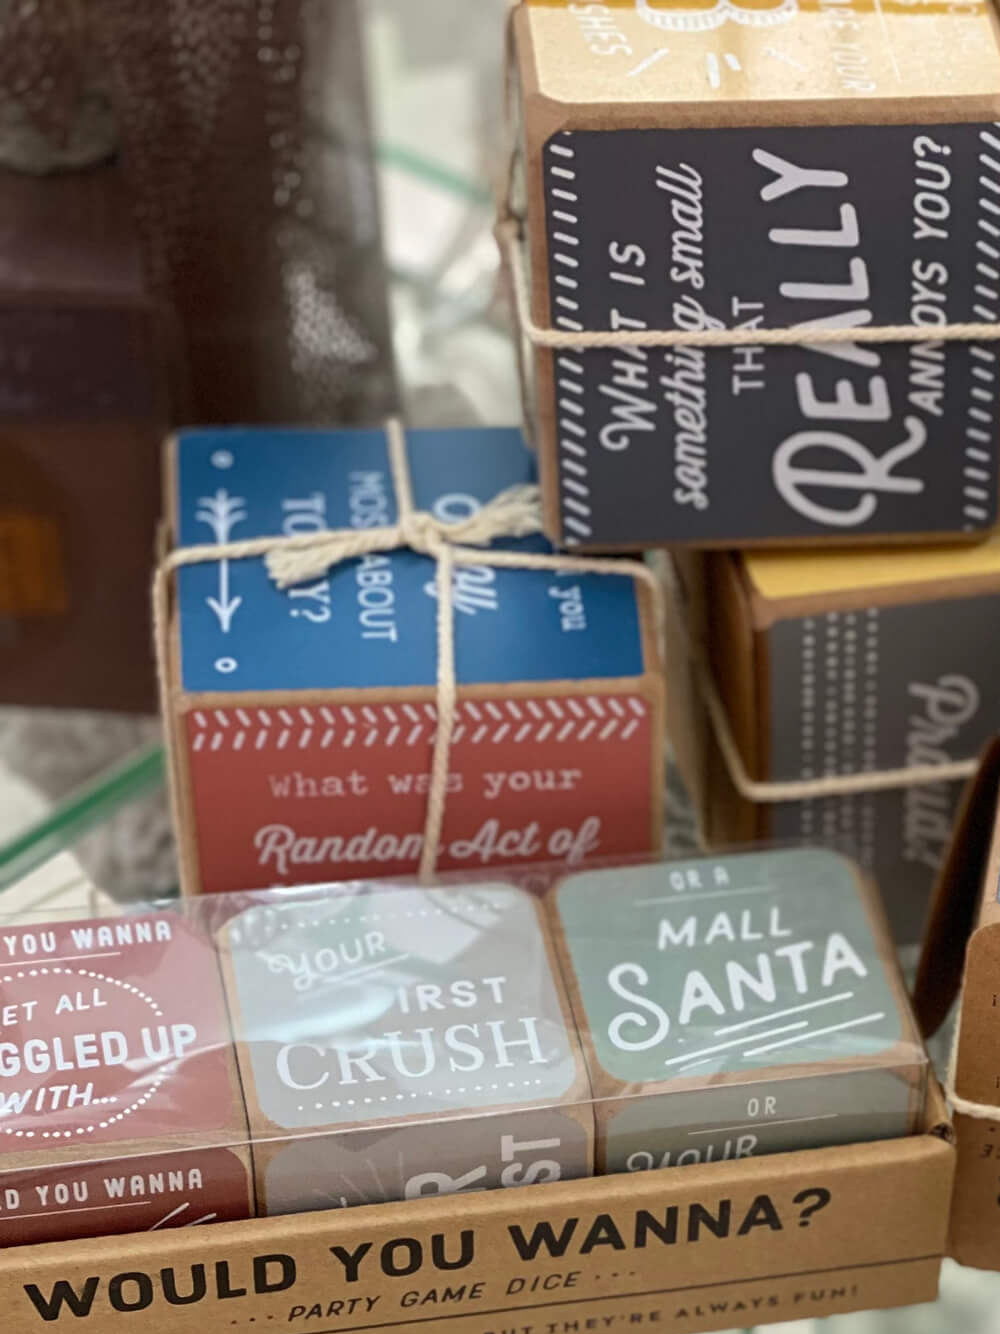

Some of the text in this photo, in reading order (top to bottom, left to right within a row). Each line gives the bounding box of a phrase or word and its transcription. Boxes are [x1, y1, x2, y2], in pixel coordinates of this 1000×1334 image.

[911, 135, 952, 241] YOU?
[599, 241, 657, 450] WHAT IS
[655, 162, 725, 509] something small
[732, 296, 765, 395] THAT
[751, 148, 926, 525] REALLY
[357, 556, 396, 642] ABOUT
[268, 768, 582, 799] what your
[449, 818, 539, 859] Act
[3, 920, 173, 955] YOU WANNA
[657, 907, 793, 951] MALL
[55, 988, 107, 1015] ALL
[606, 932, 868, 1052] SANTA
[141, 1022, 197, 1060] UP
[275, 1016, 548, 1091] CRUSH
[746, 1097, 777, 1118] OR
[36, 1168, 204, 1204] YOU WANNA
[23, 1187, 832, 1323] WOULD YOU WANNA?
[287, 1271, 582, 1323] PARTY GAME DICE
[675, 1295, 780, 1319] ALWAYS
